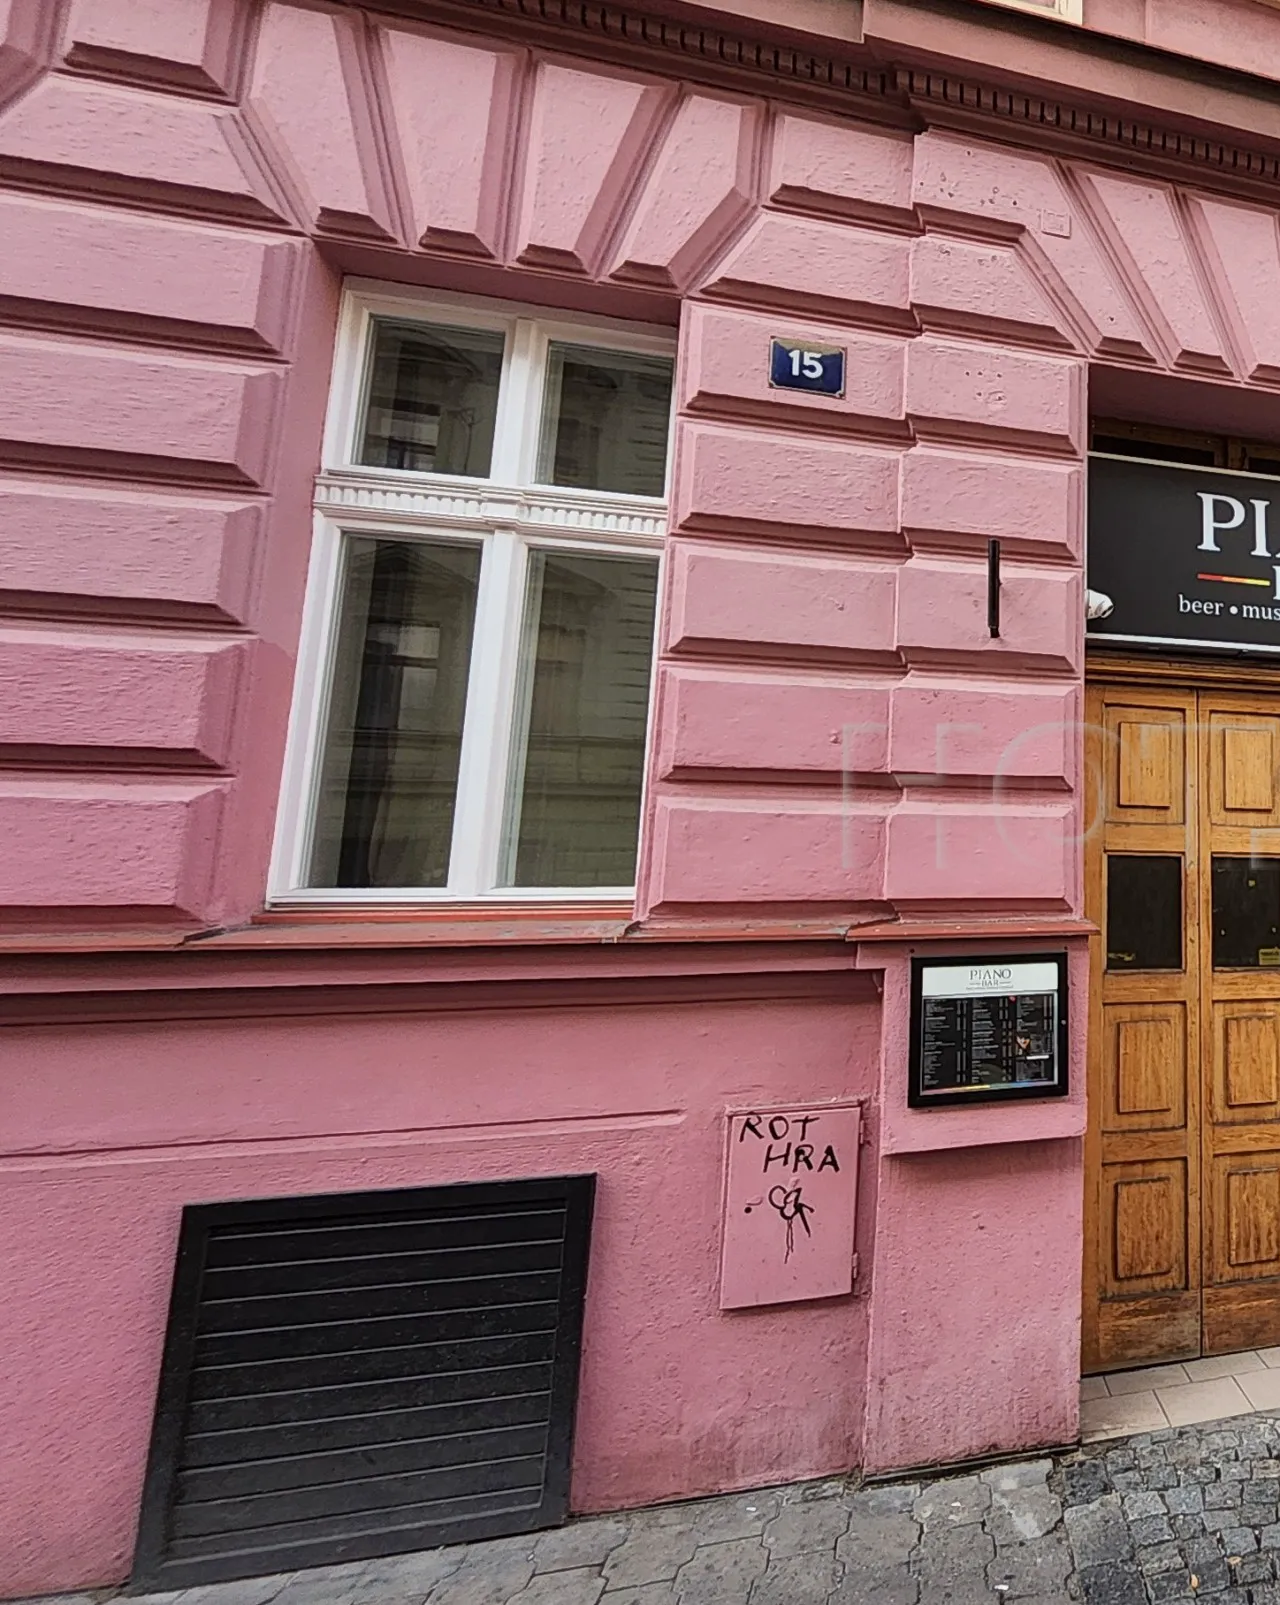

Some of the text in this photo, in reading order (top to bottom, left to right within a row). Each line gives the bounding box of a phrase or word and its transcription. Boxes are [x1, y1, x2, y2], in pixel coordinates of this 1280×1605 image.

[788, 349, 823, 379] 15
[1178, 594, 1224, 617] beer
[970, 968, 1012, 980] PIANO
[739, 1111, 820, 1143] ROT
[763, 1142, 840, 1174] HRA
